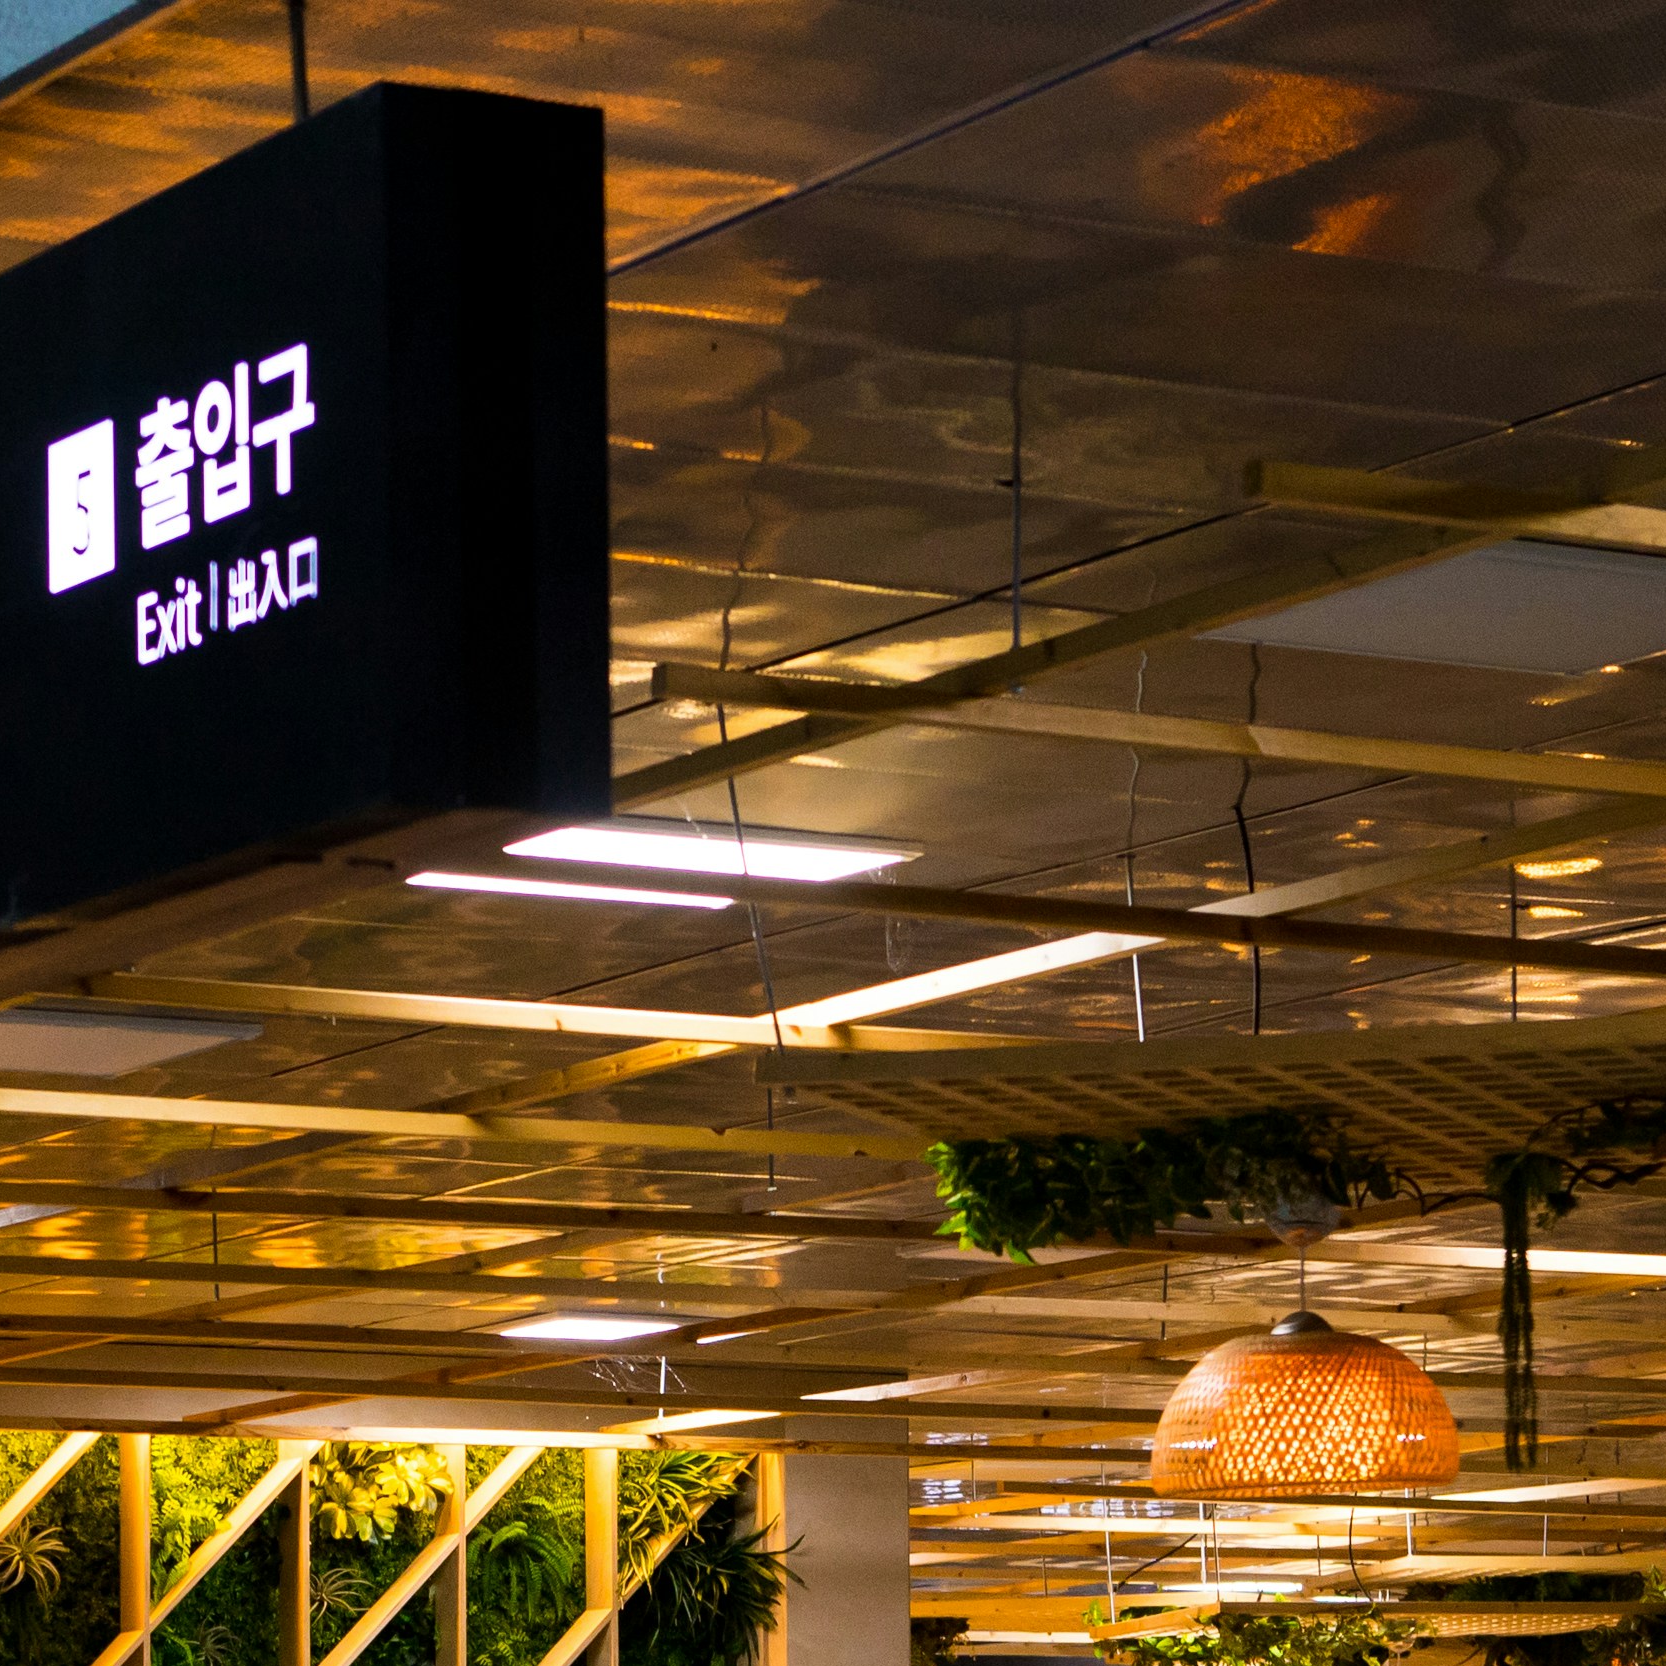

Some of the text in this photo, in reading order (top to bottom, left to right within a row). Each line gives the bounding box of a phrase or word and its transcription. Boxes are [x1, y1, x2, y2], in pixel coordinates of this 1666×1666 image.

[72, 342, 316, 556] 5 출입구
[137, 536, 318, 666] Exit 出入口
